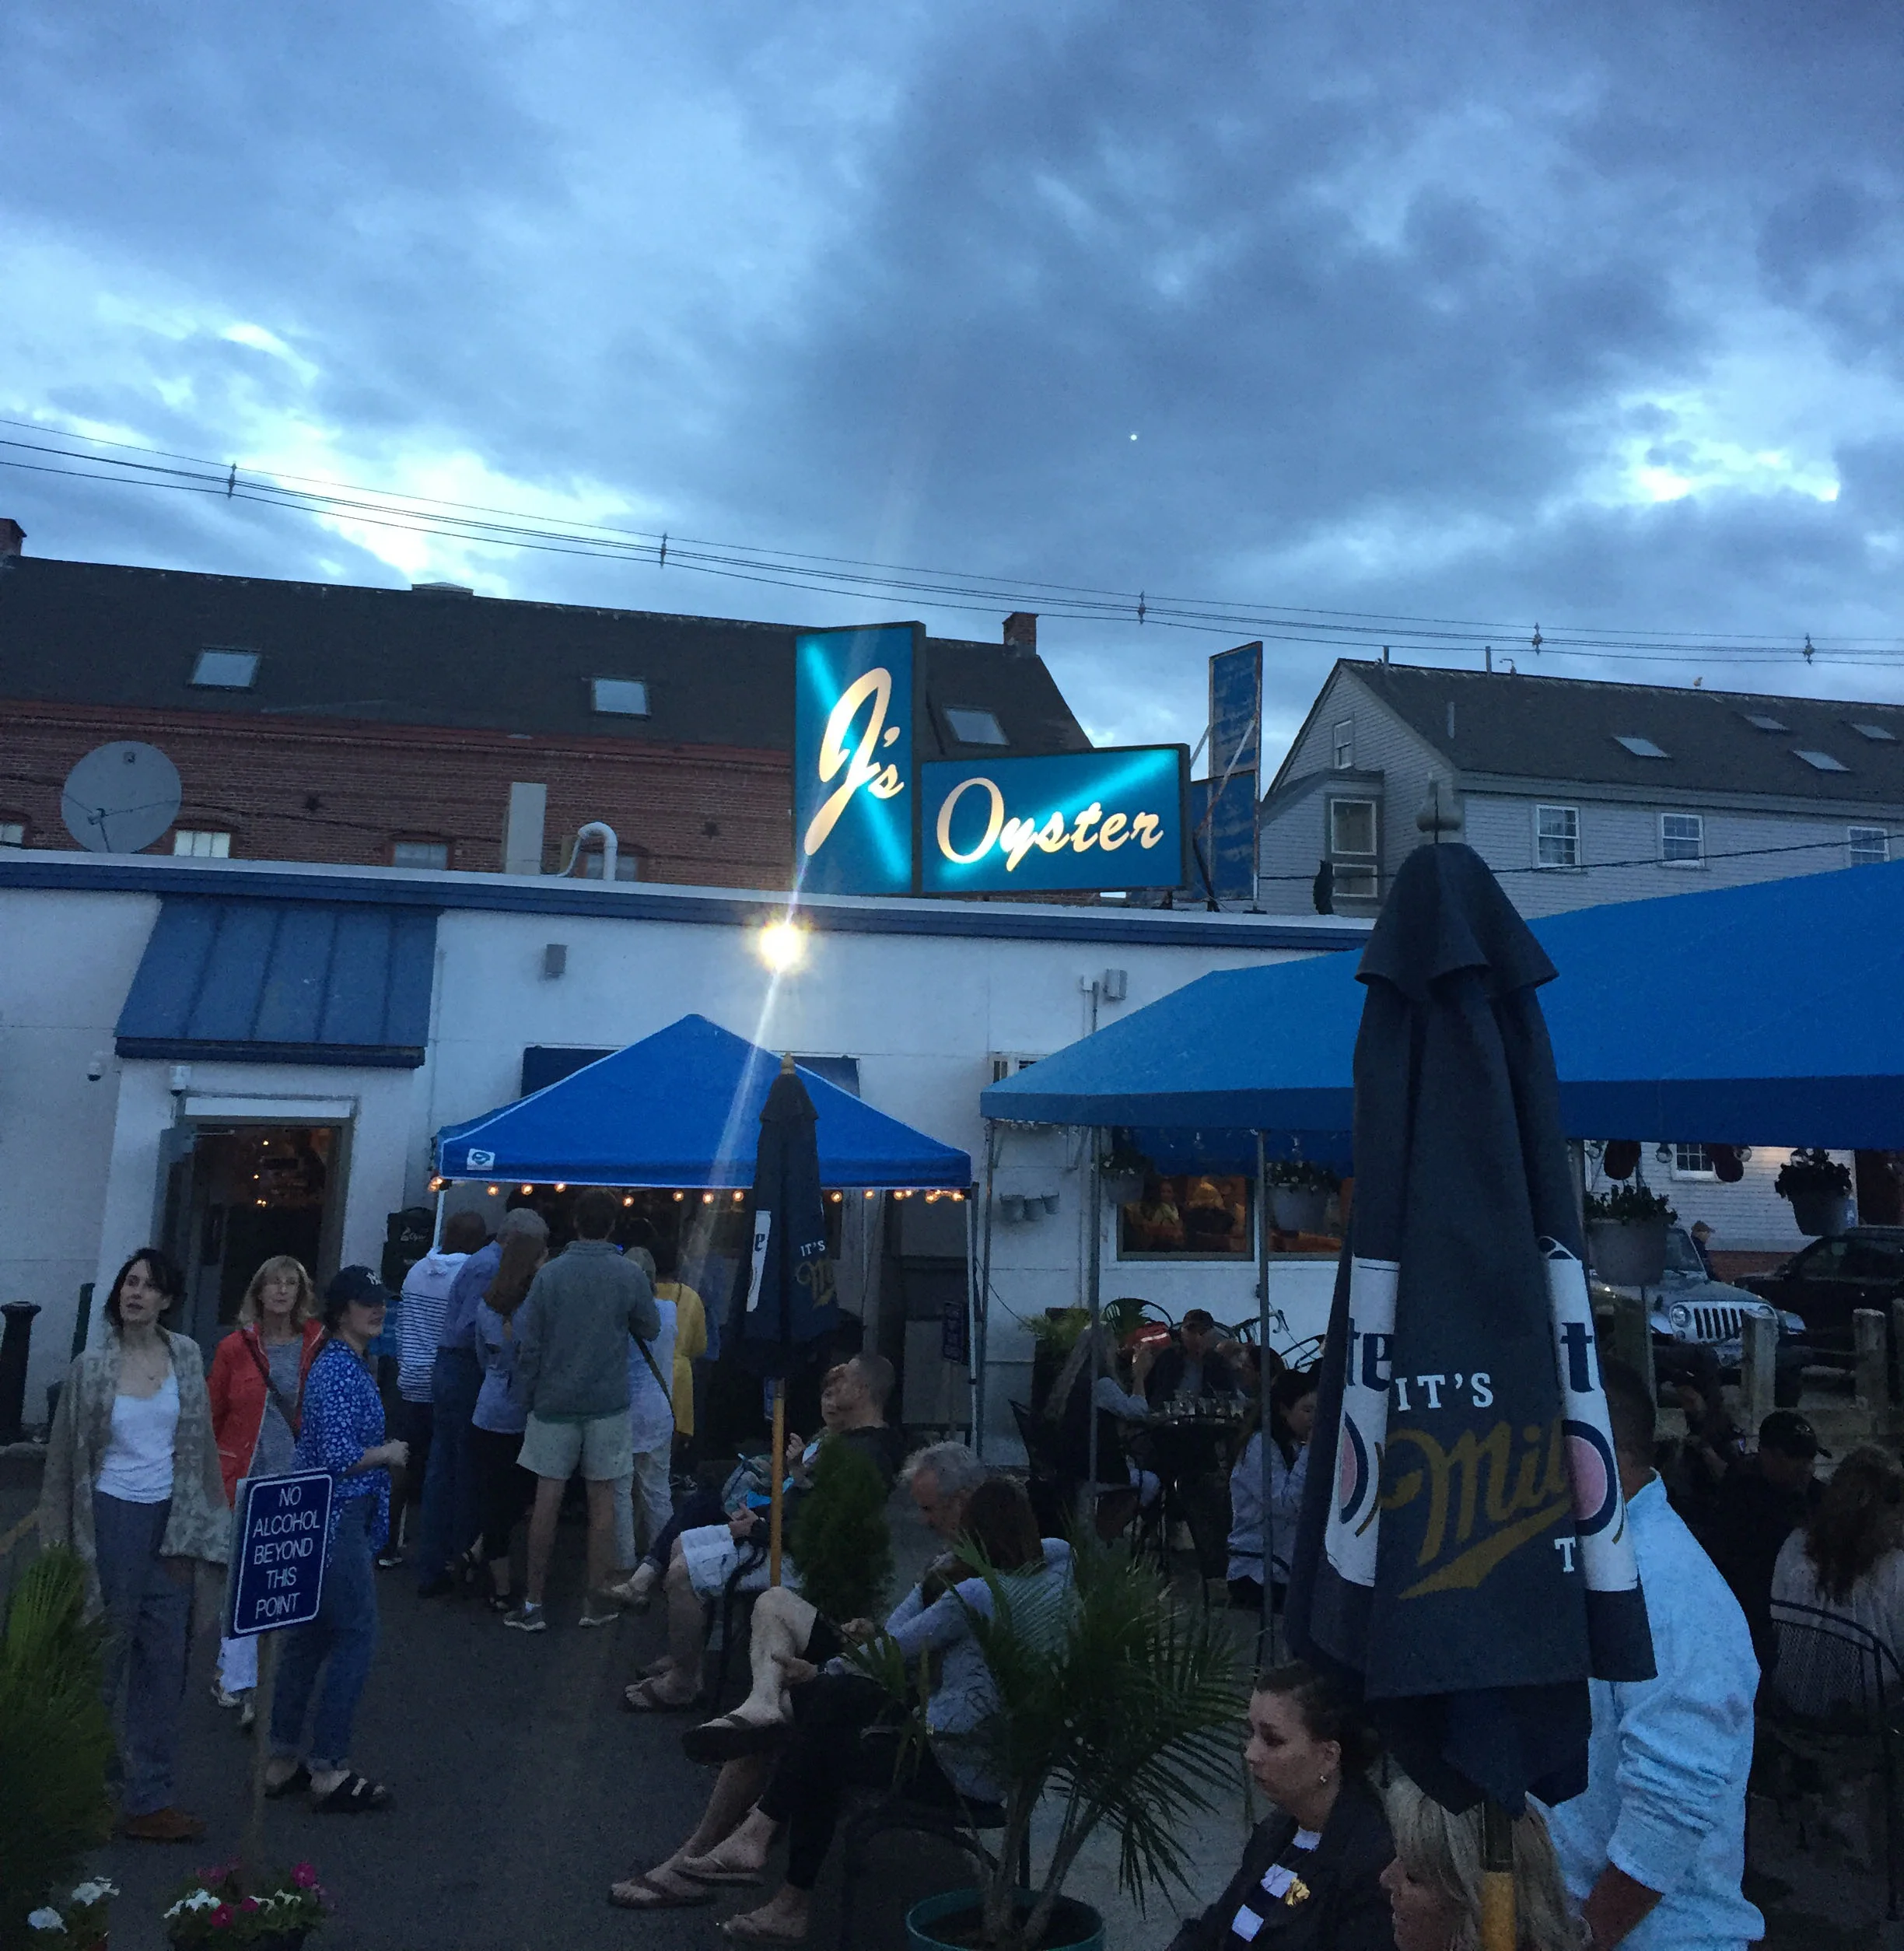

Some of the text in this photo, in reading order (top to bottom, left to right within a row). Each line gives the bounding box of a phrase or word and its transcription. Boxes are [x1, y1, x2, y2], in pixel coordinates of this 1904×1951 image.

[805, 667, 905, 856] J's
[936, 777, 1164, 872] Oyster
[800, 1240, 826, 1257] IT'S
[1395, 1372, 1495, 1412] IT'S
[278, 1485, 302, 1508] NO
[253, 1509, 320, 1538] ALCOHOL
[254, 1537, 314, 1565] BEYOND
[1554, 1536, 1577, 1573] T
[266, 1566, 298, 1590] THIS
[255, 1592, 301, 1620] POINT
